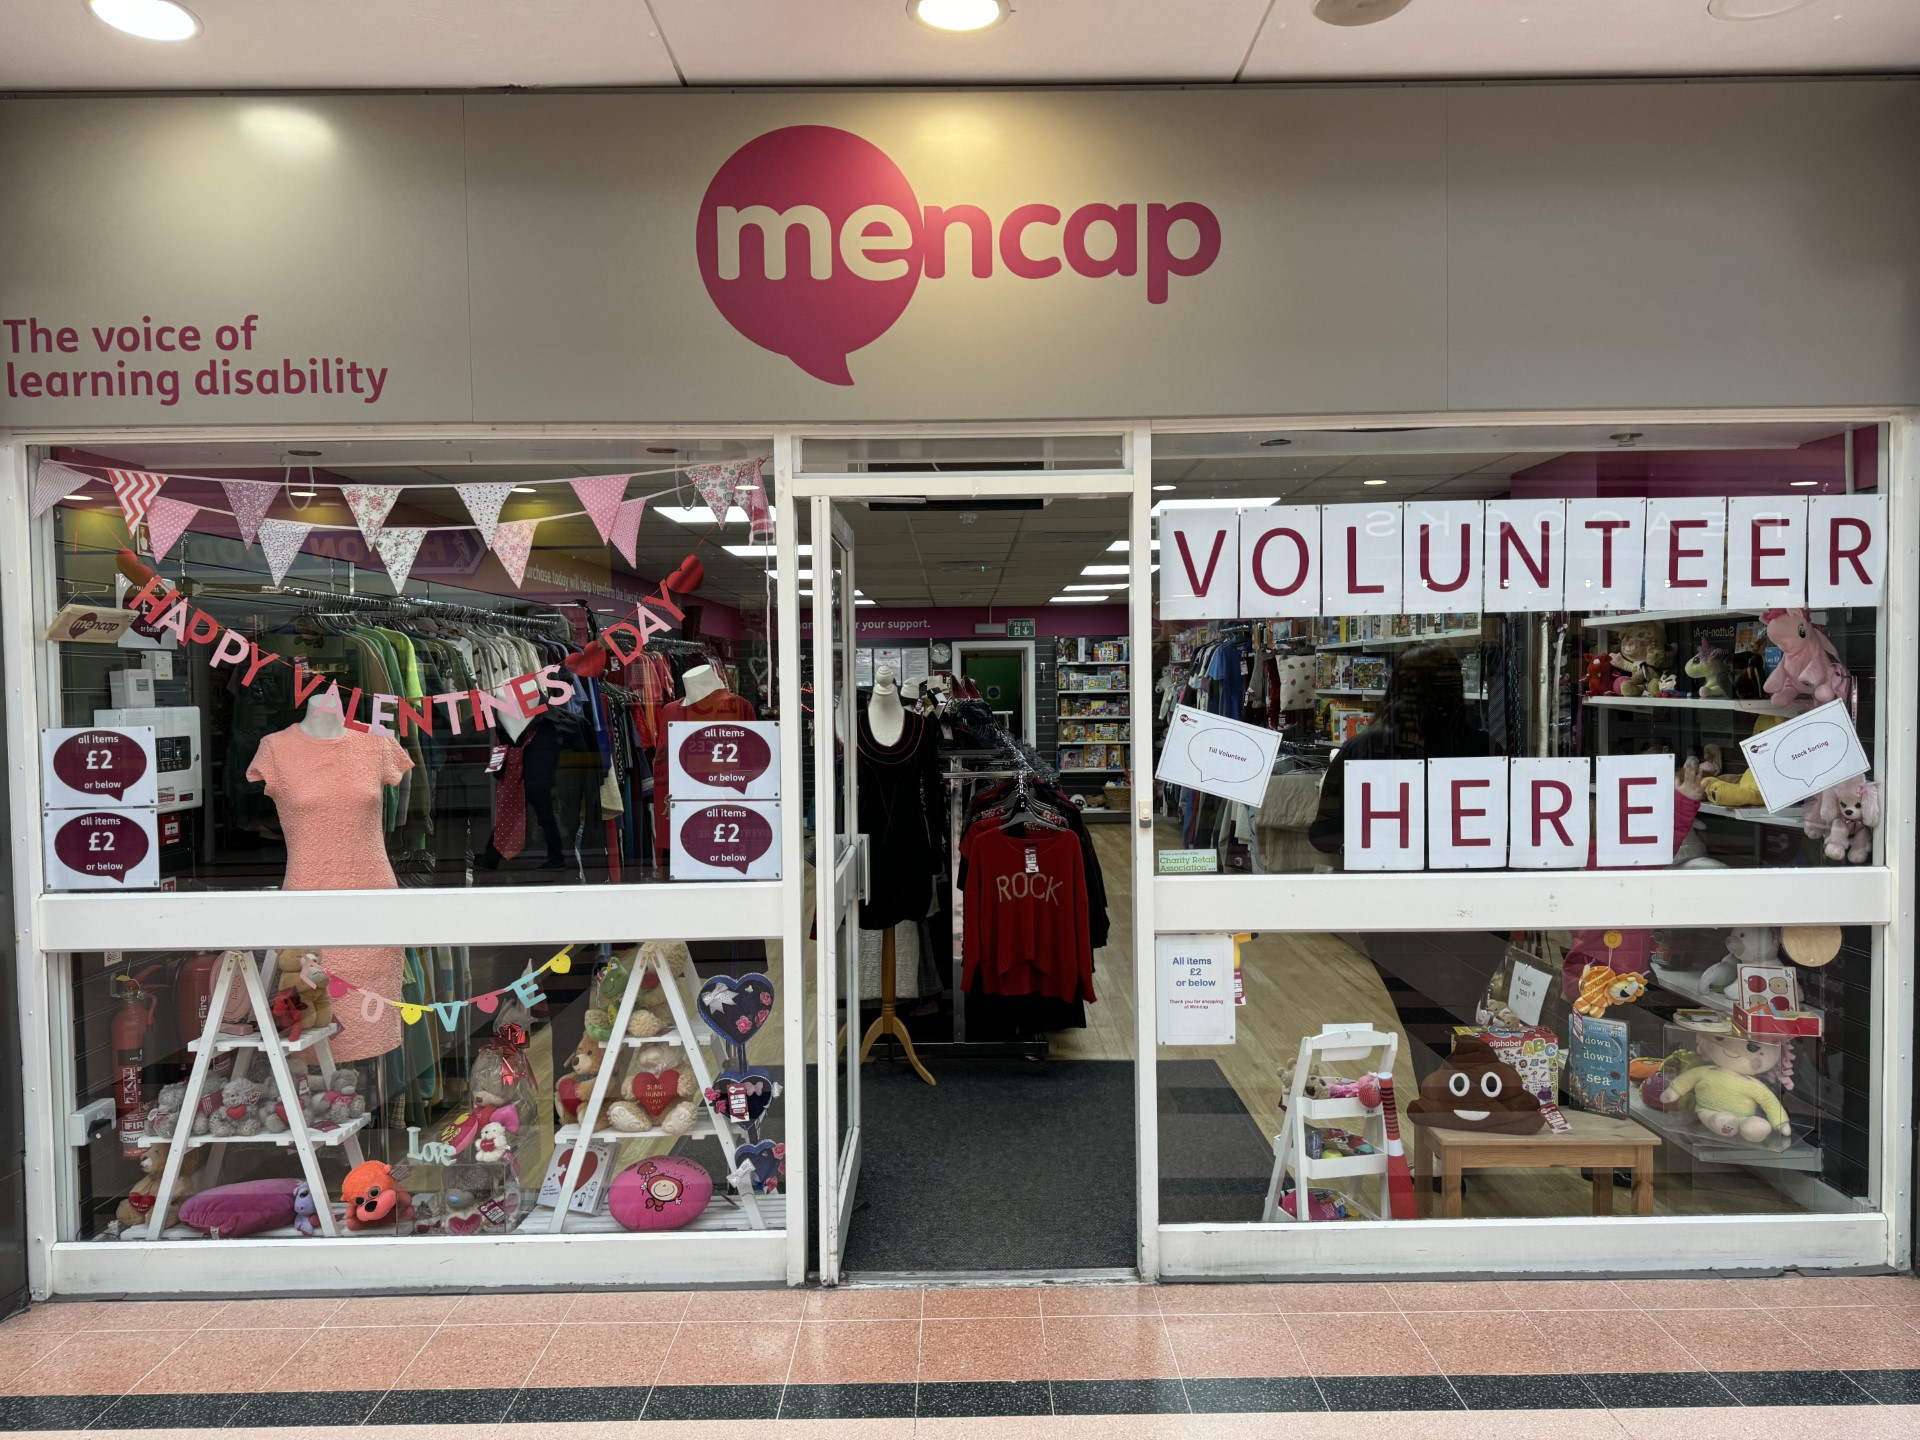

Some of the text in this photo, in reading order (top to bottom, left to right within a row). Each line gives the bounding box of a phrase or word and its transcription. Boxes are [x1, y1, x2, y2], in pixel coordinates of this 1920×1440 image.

[716, 201, 1222, 305] mencap
[3, 314, 259, 353] The voice of
[7, 357, 388, 406] learning disability
[1172, 516, 1874, 599] VOLUNTEER
[552, 569, 569, 591] today
[72, 618, 120, 634] mencap
[602, 578, 687, 666] DAY
[861, 620, 886, 632] your
[887, 618, 931, 631] support.
[128, 574, 281, 688] HAPPY
[294, 664, 573, 738] VALENTINES
[78, 735, 119, 744] all items
[704, 729, 745, 738] all items
[711, 743, 739, 763] £2
[1208, 746, 1247, 763] Till Volunteer
[1791, 740, 1829, 761] Stock Sorting
[85, 749, 113, 770] £2
[95, 781, 121, 789] below
[708, 773, 746, 782] or below
[706, 809, 747, 818] all items
[1361, 776, 1659, 849] HERE
[80, 817, 121, 826] all items
[713, 823, 740, 843] £2
[88, 831, 115, 852] £2
[721, 853, 747, 862] below
[1160, 855, 1216, 865] Charity Retail
[97, 862, 123, 871] below
[1160, 864, 1207, 872] Association
[996, 872, 1063, 906] ROCK
[1172, 957, 1212, 966] All items
[1190, 968, 1202, 976] £2
[1188, 979, 1216, 987] below
[1588, 1024, 1607, 1033] down
[1489, 1039, 1521, 1049] alphabet
[1522, 1037, 1558, 1058] ABC
[1584, 1035, 1612, 1048] down
[1583, 1050, 1613, 1064] down
[1586, 1073, 1611, 1087] sea
[124, 1121, 144, 1131] FIR
[406, 1125, 458, 1167] Love
[676, 1158, 707, 1176] Devil
